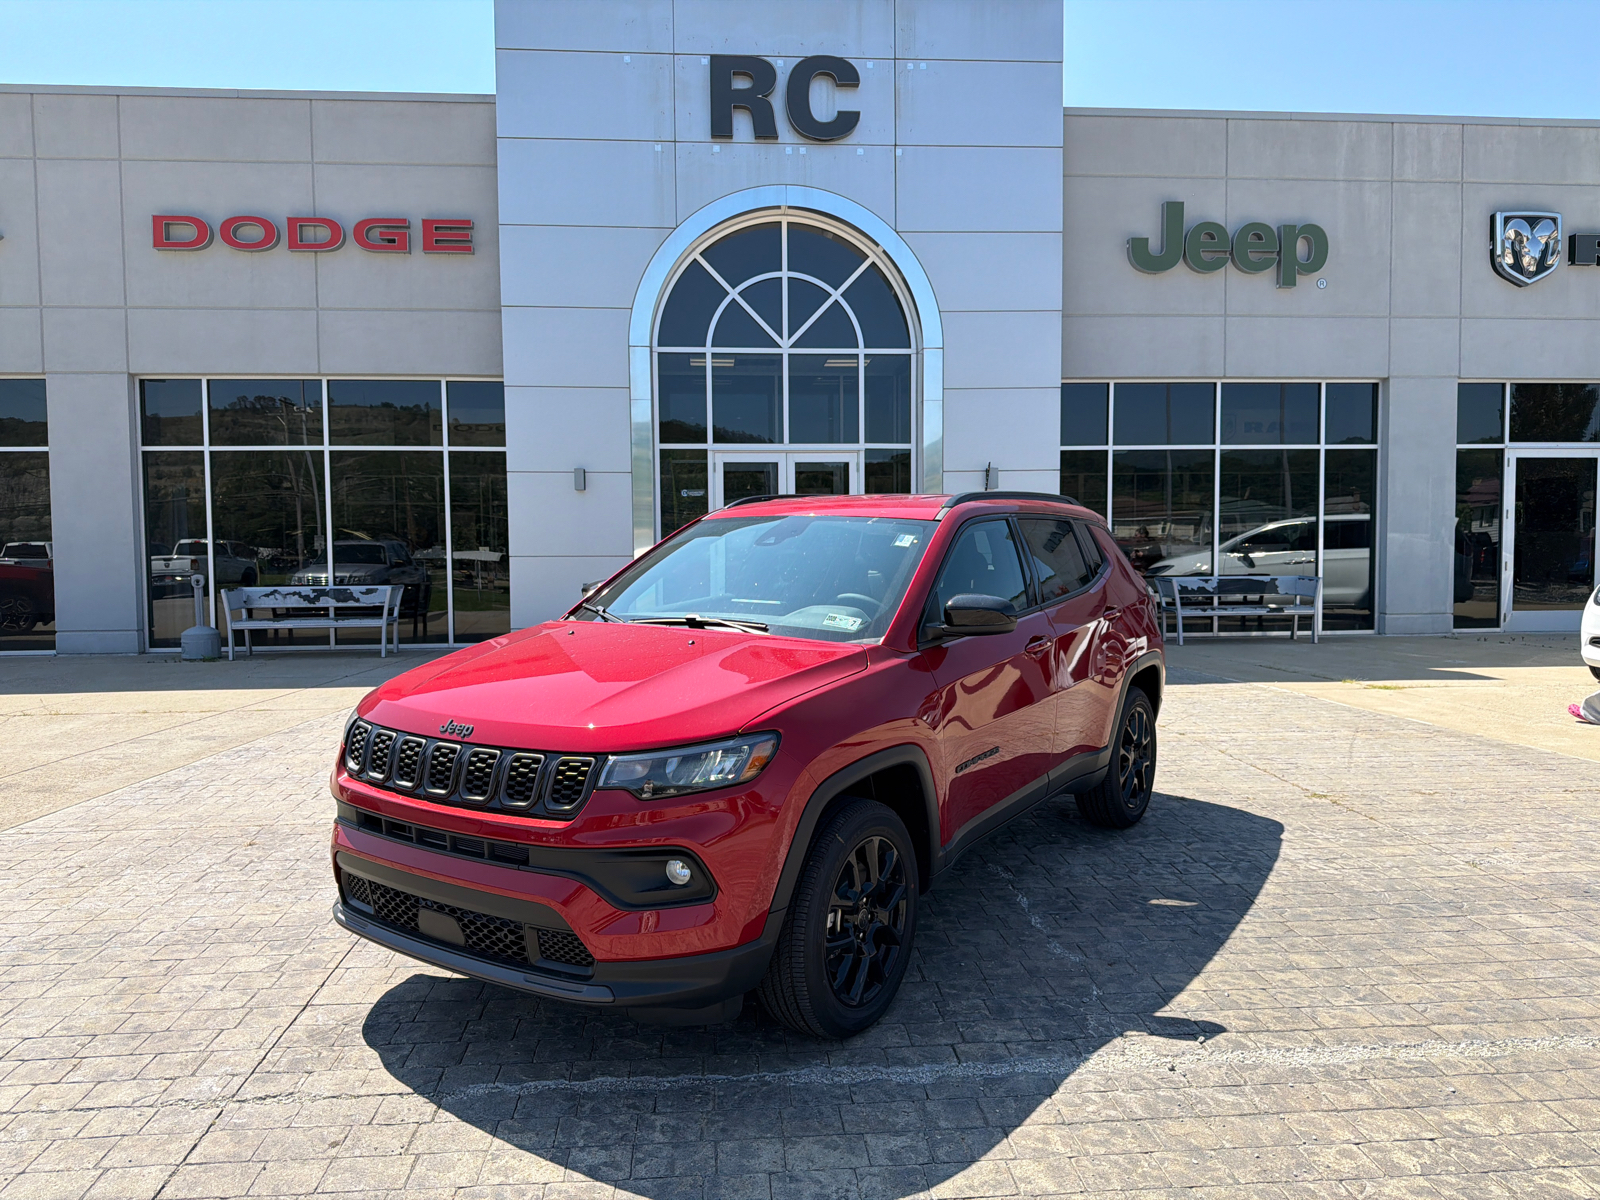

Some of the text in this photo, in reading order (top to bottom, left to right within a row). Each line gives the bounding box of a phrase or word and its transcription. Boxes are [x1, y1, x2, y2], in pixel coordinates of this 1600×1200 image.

[710, 54, 861, 142] RC
[152, 215, 475, 255] DODGE
[1126, 201, 1329, 289] Jeep
[439, 719, 474, 740] Jeep
